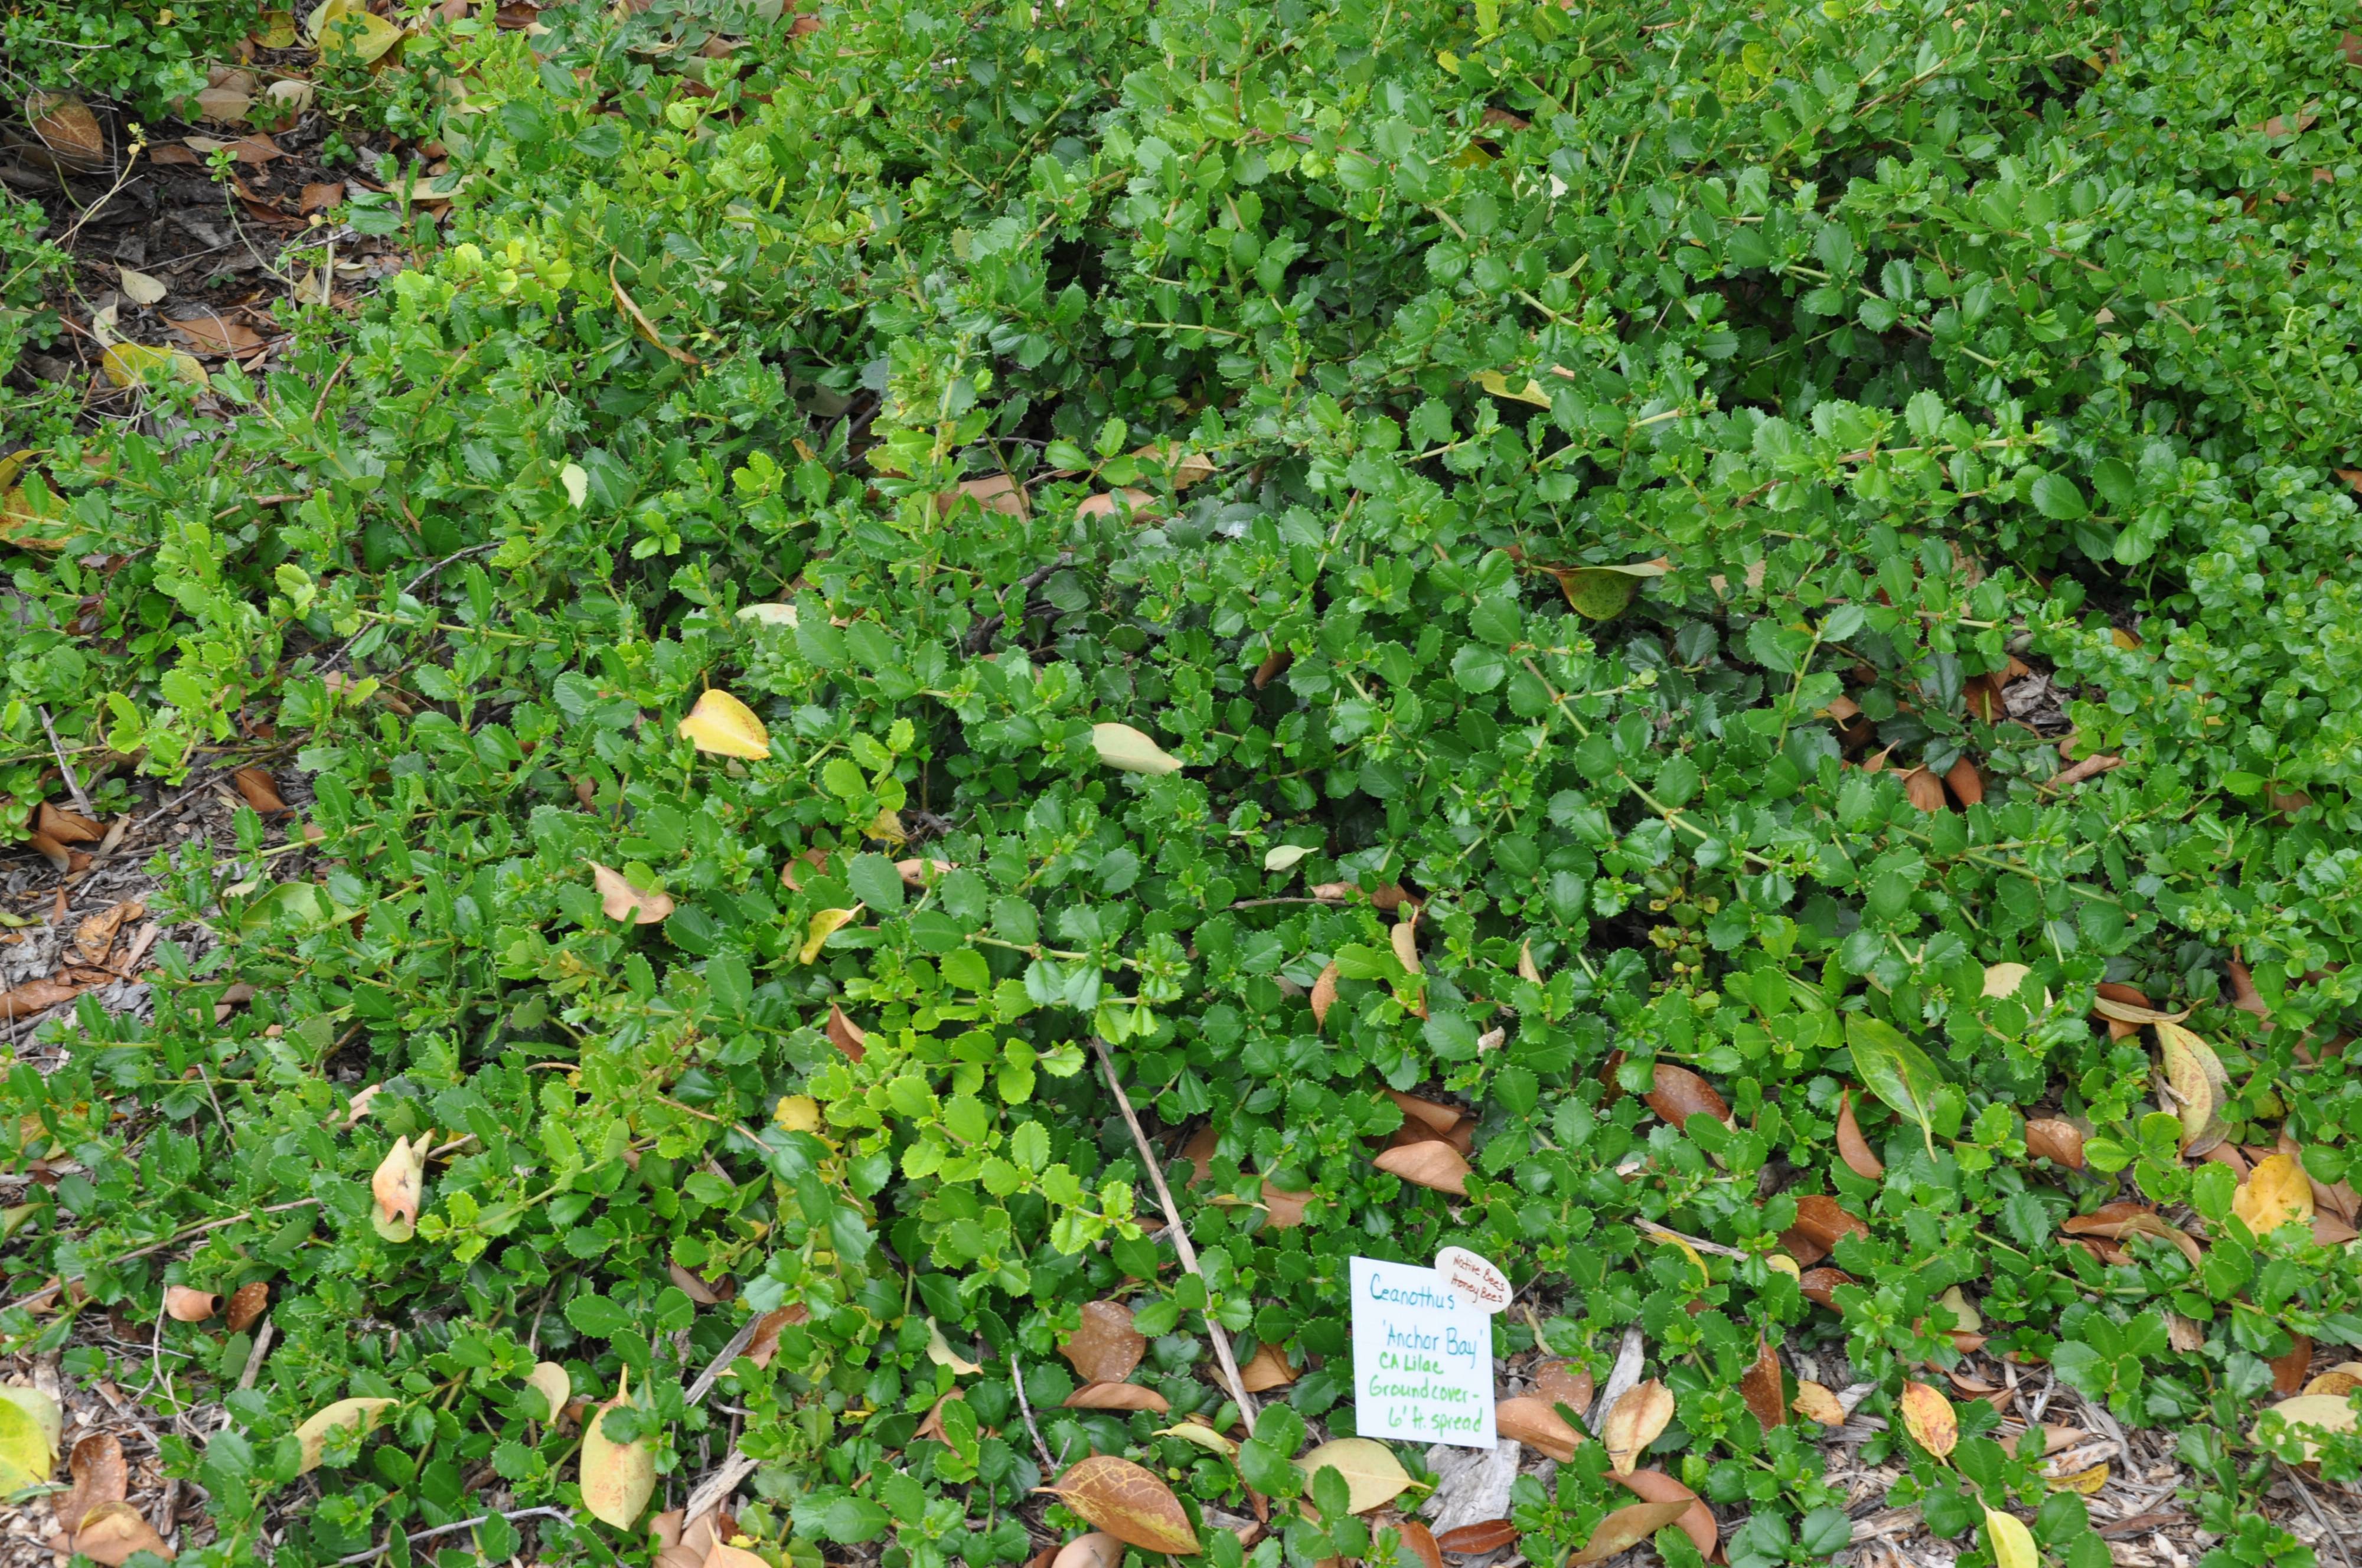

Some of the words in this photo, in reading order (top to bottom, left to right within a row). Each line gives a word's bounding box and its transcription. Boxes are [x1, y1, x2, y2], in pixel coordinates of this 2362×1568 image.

[1370, 1273, 1455, 1310] Ceanothus
[1451, 1272, 1479, 1303] Honey
[1480, 1287, 1504, 1303] Bees
[1483, 1268, 1505, 1292] Bees
[1379, 1351, 1399, 1370] CA
[1404, 1353, 1444, 1375] Lilac
[1412, 1406, 1427, 1429] ft.
[1431, 1407, 1483, 1437] spread
